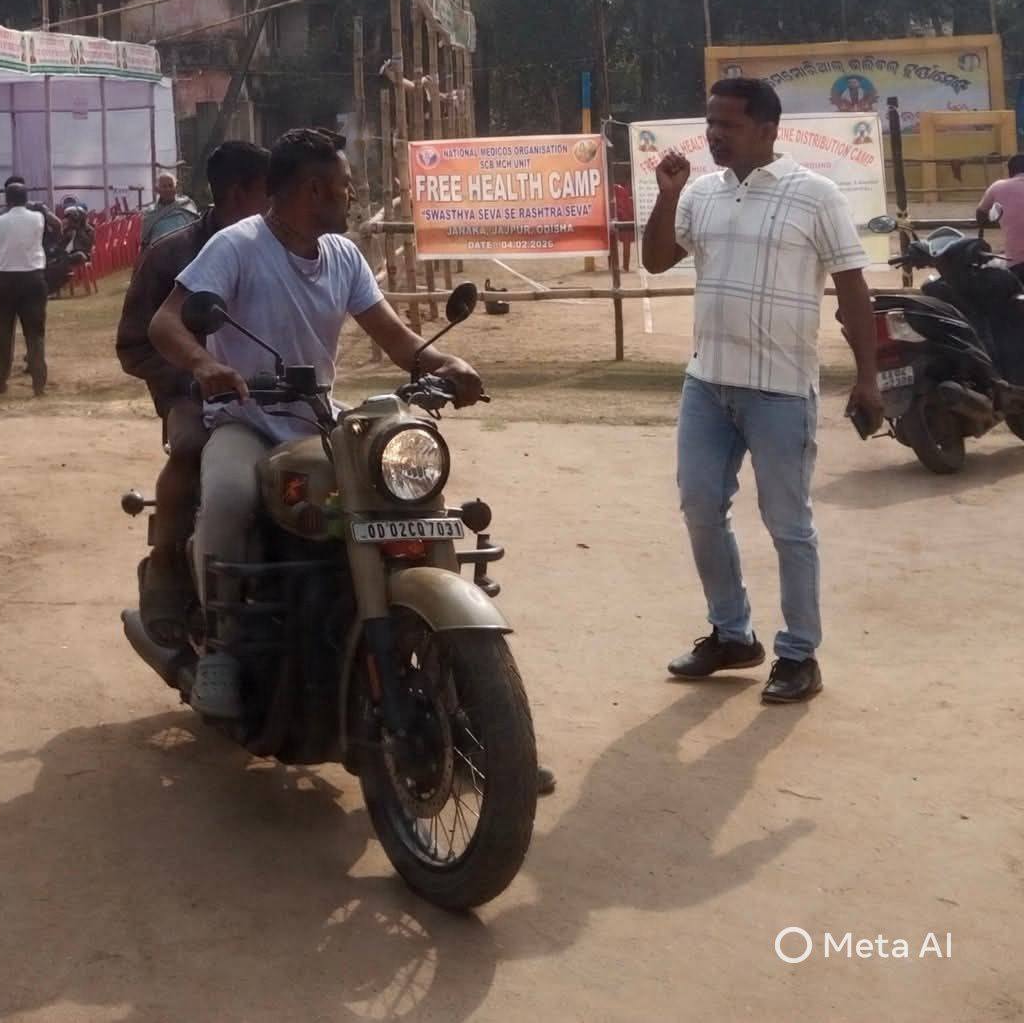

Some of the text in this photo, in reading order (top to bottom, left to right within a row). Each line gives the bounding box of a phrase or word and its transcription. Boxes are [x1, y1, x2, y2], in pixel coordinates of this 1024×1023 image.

[443, 144, 568, 158] NATIONAL MEDICOS ORGANISATION
[796, 129, 849, 159] DISTRIBUTION
[850, 146, 875, 168] CAMP
[480, 158, 530, 169] SCB MCH UNIT
[415, 168, 601, 202] FREE HEALTH CAMP
[478, 208, 501, 219] SEVA
[504, 207, 516, 219] SE
[519, 206, 563, 218] RASHTRA
[536, 223, 575, 234] ODISHA
[430, 521, 462, 537] 7031
